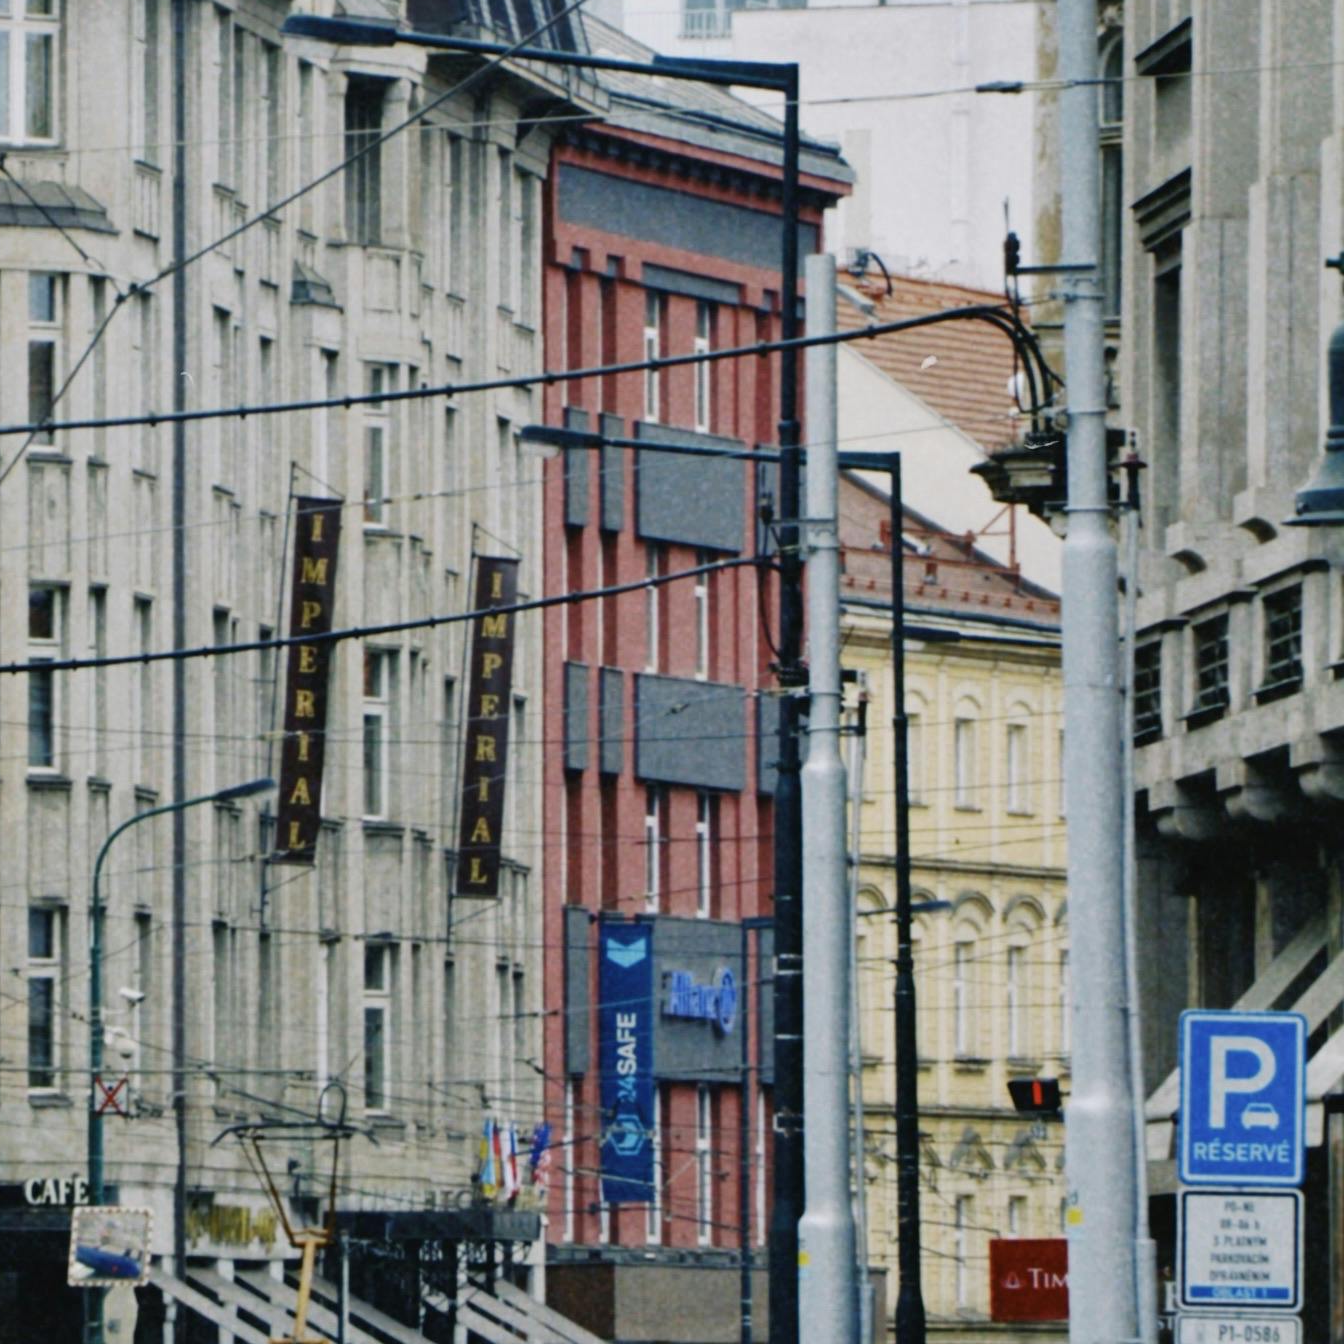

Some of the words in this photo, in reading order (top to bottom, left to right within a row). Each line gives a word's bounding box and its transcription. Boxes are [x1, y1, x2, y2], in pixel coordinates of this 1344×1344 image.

[288, 513, 327, 850] IMPERIAL
[469, 570, 507, 885] IMPERIAL
[1208, 1034, 1277, 1130] P
[1193, 1137, 1290, 1164] RÉSERVÉ
[24, 1173, 90, 1205] CAFÉ
[1218, 1324, 1281, 1343] P1-0586
